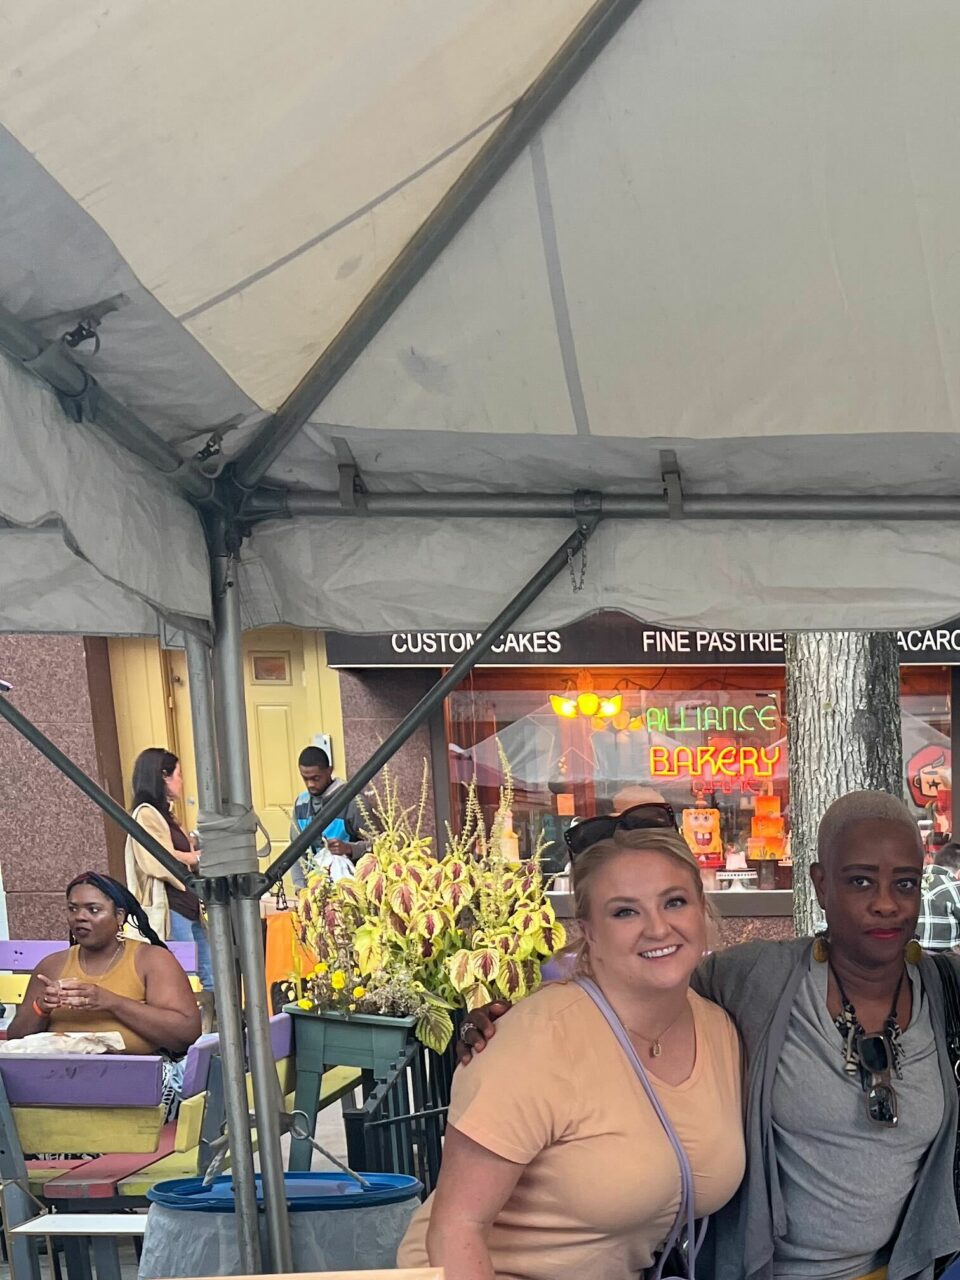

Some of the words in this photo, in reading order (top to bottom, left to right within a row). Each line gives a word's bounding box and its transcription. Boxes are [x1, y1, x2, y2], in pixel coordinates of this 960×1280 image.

[643, 631, 690, 652] FINE
[697, 631, 788, 652] PASTRIE
[646, 705, 777, 733] ALLIANCE
[649, 746, 780, 777] BAKERY
